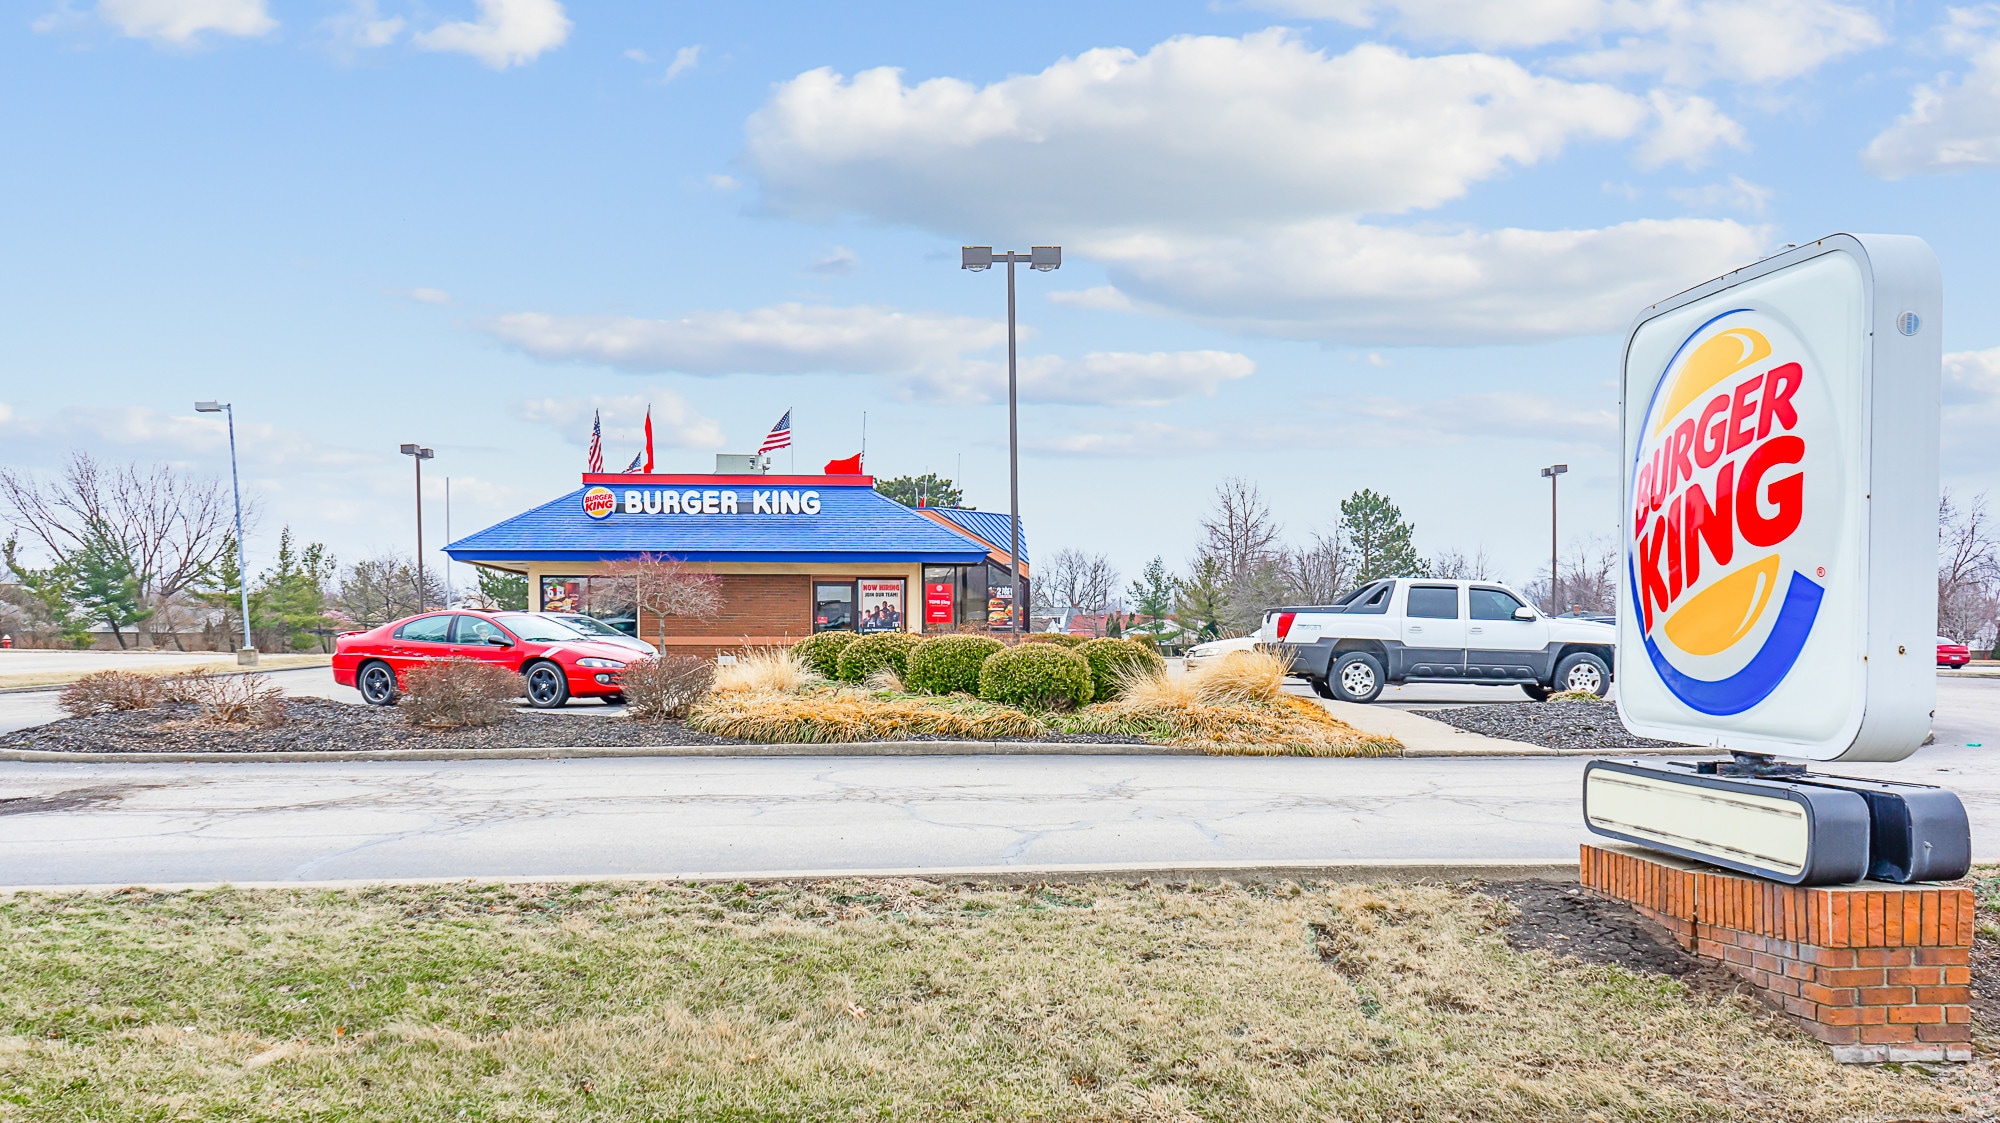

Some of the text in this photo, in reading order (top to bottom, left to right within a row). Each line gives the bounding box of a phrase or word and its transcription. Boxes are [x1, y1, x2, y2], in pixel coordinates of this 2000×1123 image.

[1635, 361, 1803, 539] BURGER
[585, 494, 613, 503] BURGER
[585, 500, 614, 512] KING
[624, 490, 821, 515] BURGER KING
[1639, 435, 1806, 636] KING
